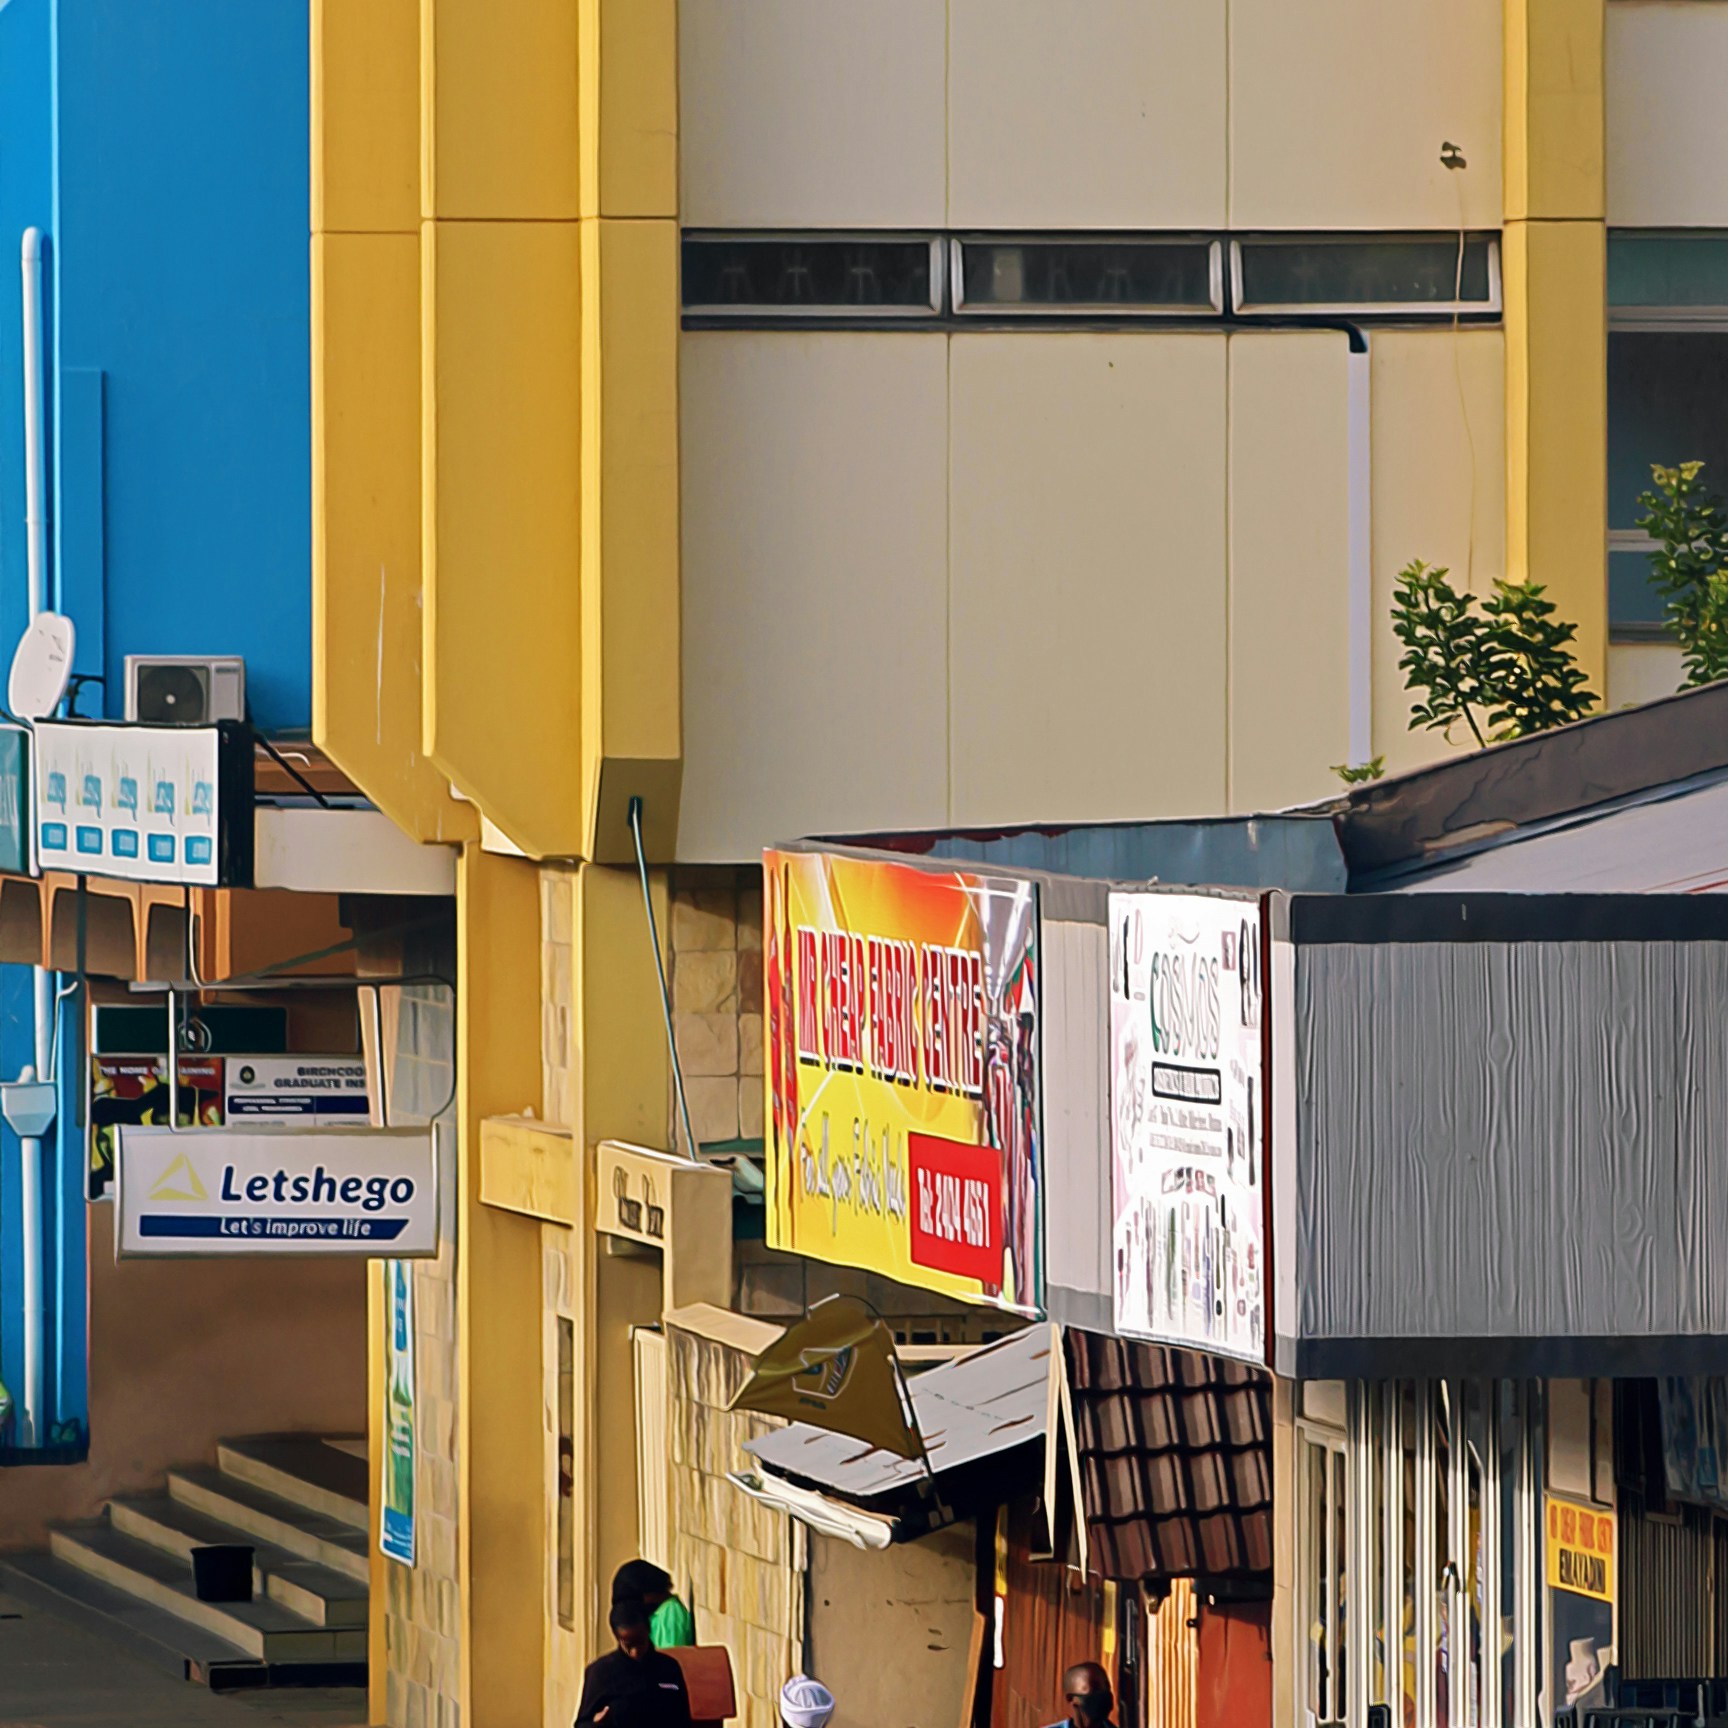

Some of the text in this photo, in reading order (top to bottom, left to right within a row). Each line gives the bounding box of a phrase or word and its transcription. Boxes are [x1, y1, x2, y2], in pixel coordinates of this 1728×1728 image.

[820, 929, 866, 1068] CHEAP
[867, 934, 920, 1084] FABRIC
[921, 941, 984, 1094] CENTRE
[273, 1078, 341, 1088] GRADUATE
[220, 1165, 415, 1211] Letshego
[220, 1217, 372, 1237] Let's improve life
